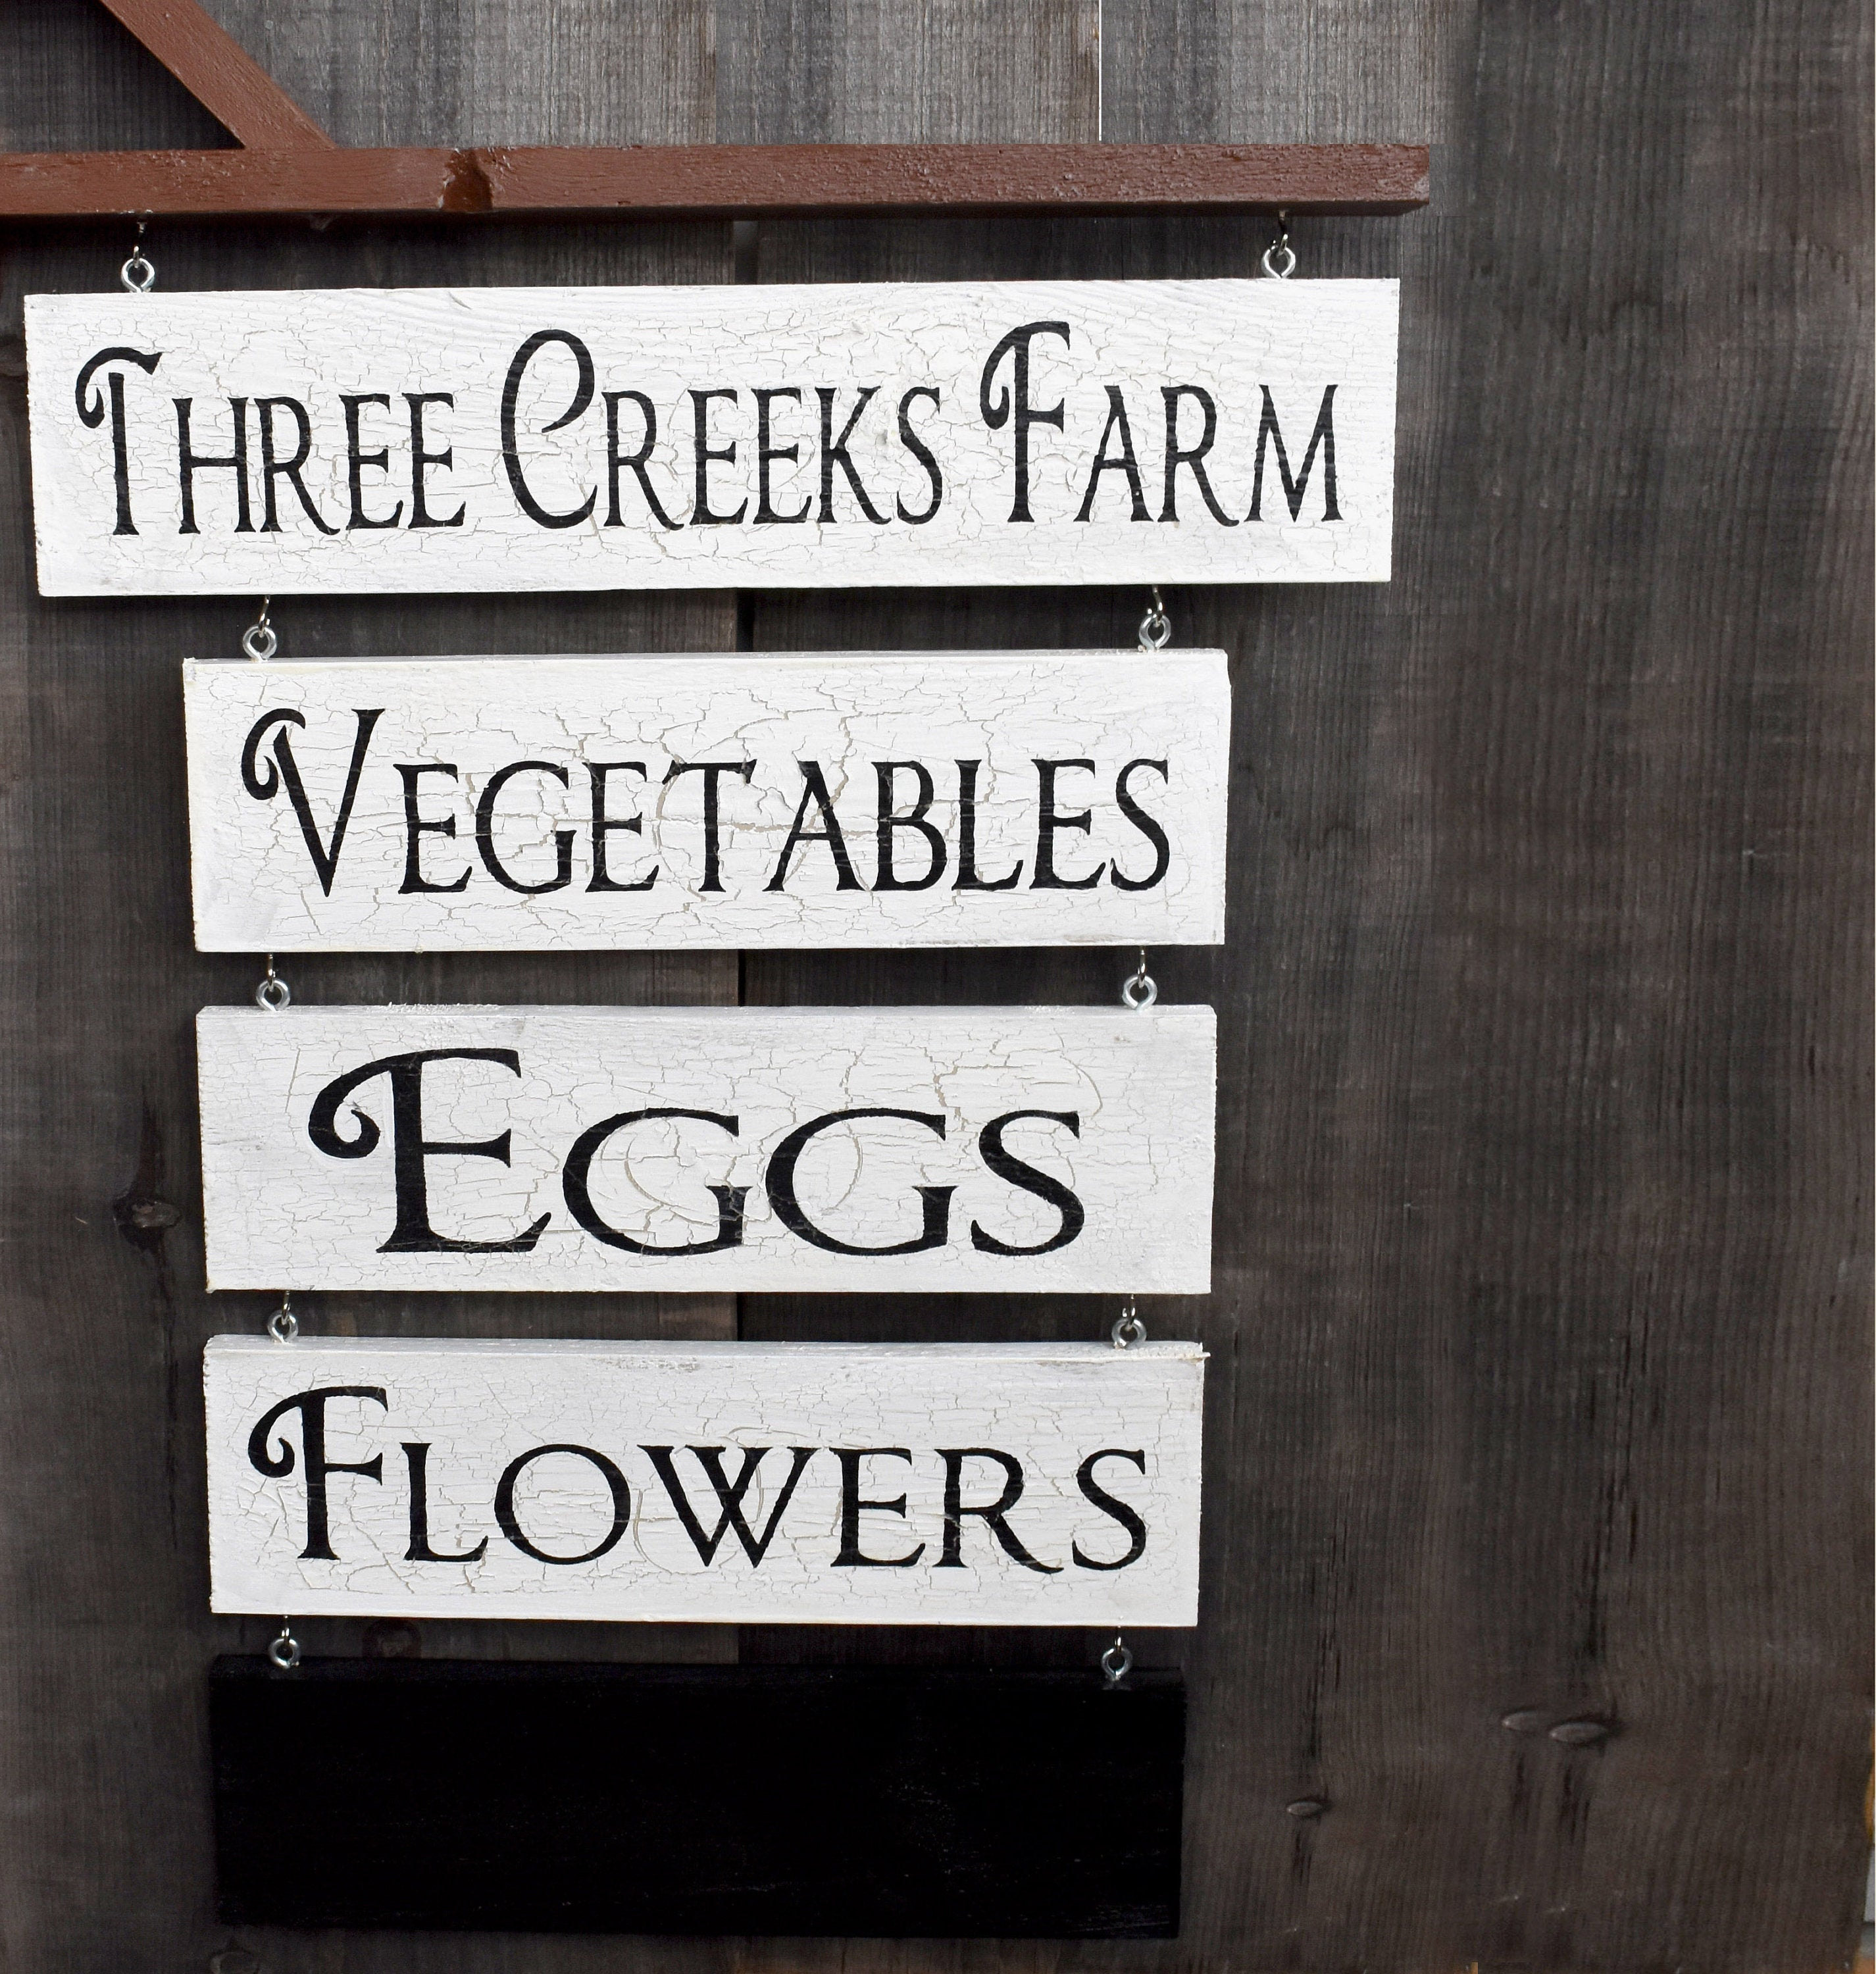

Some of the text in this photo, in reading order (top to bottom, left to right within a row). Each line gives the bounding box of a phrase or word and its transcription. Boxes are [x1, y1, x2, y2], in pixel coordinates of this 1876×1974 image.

[241, 708, 1170, 898] VEGETABLES
[308, 1048, 1085, 1257] EGGS
[247, 1386, 1146, 1575] FLOWERS
